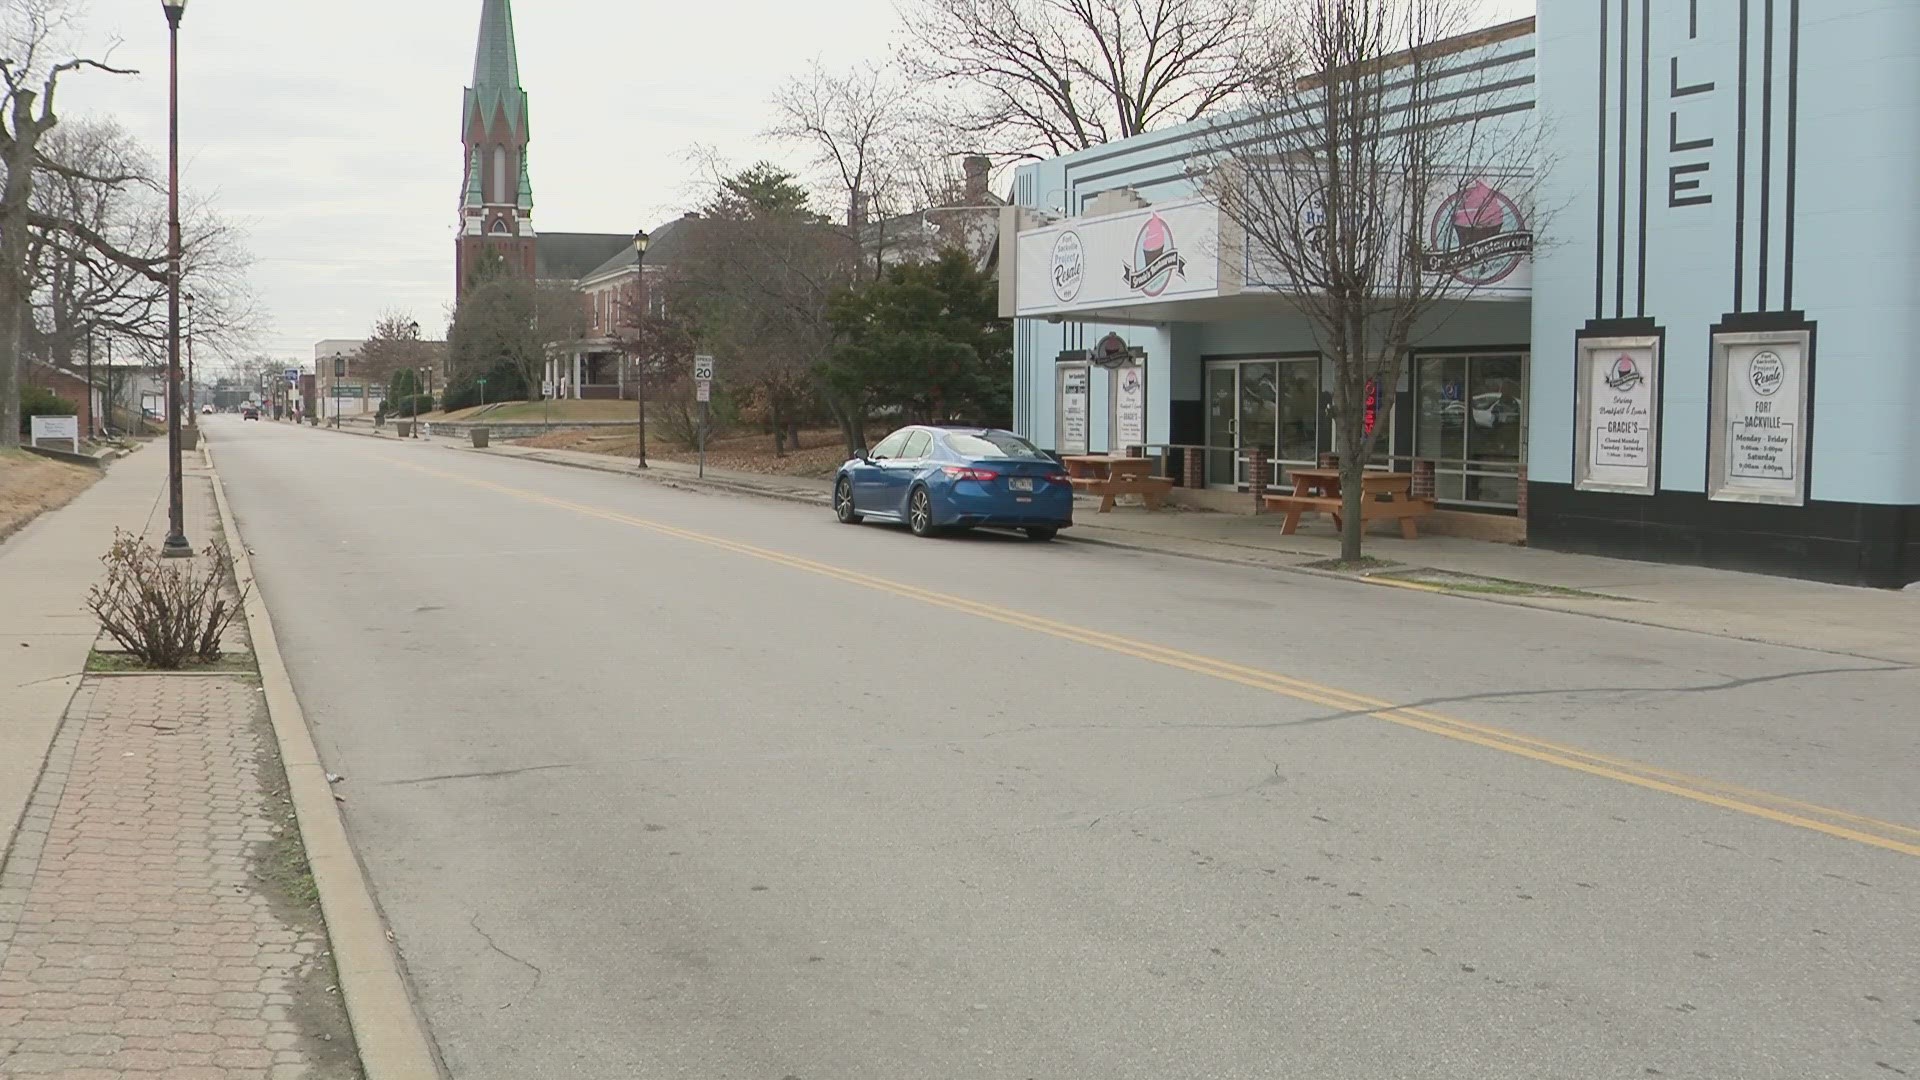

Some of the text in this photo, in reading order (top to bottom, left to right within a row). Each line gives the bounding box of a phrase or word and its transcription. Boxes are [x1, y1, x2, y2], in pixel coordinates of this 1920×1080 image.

[1471, 236, 1530, 258] Restaurant
[1054, 254, 1080, 287] Resale
[696, 368, 711, 378] 20
[1752, 366, 1780, 386] Resale
[1755, 401, 1772, 414] FORT
[1607, 421, 1638, 434] GRACIE'S
[1744, 415, 1781, 429] SACKVILLE
[1736, 434, 1762, 443] Monday
[1767, 435, 1788, 445] Friday
[1747, 453, 1776, 463] Saturday
